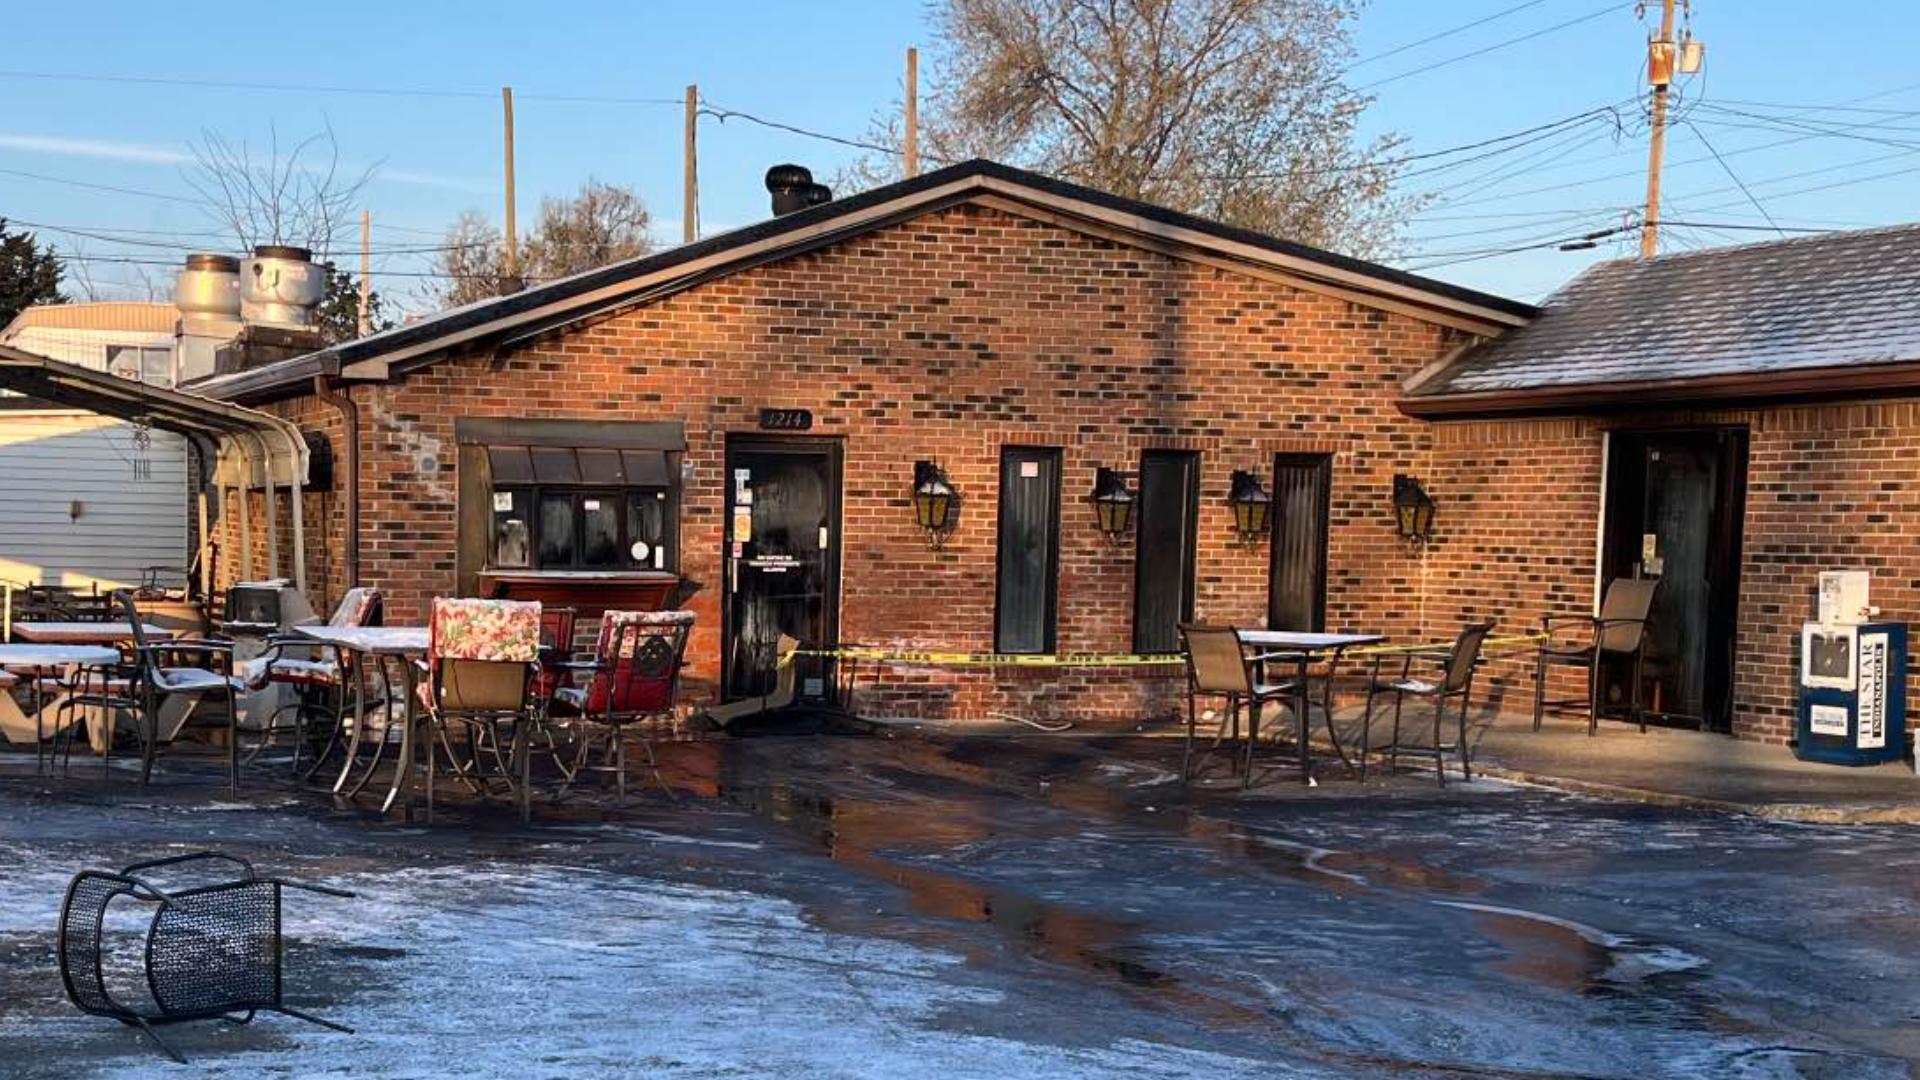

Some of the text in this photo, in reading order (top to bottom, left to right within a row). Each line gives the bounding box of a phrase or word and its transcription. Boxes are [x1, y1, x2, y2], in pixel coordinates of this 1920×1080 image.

[1860, 643, 1873, 735] THE STAR
[1873, 649, 1883, 733] INDIANAPOLIS
